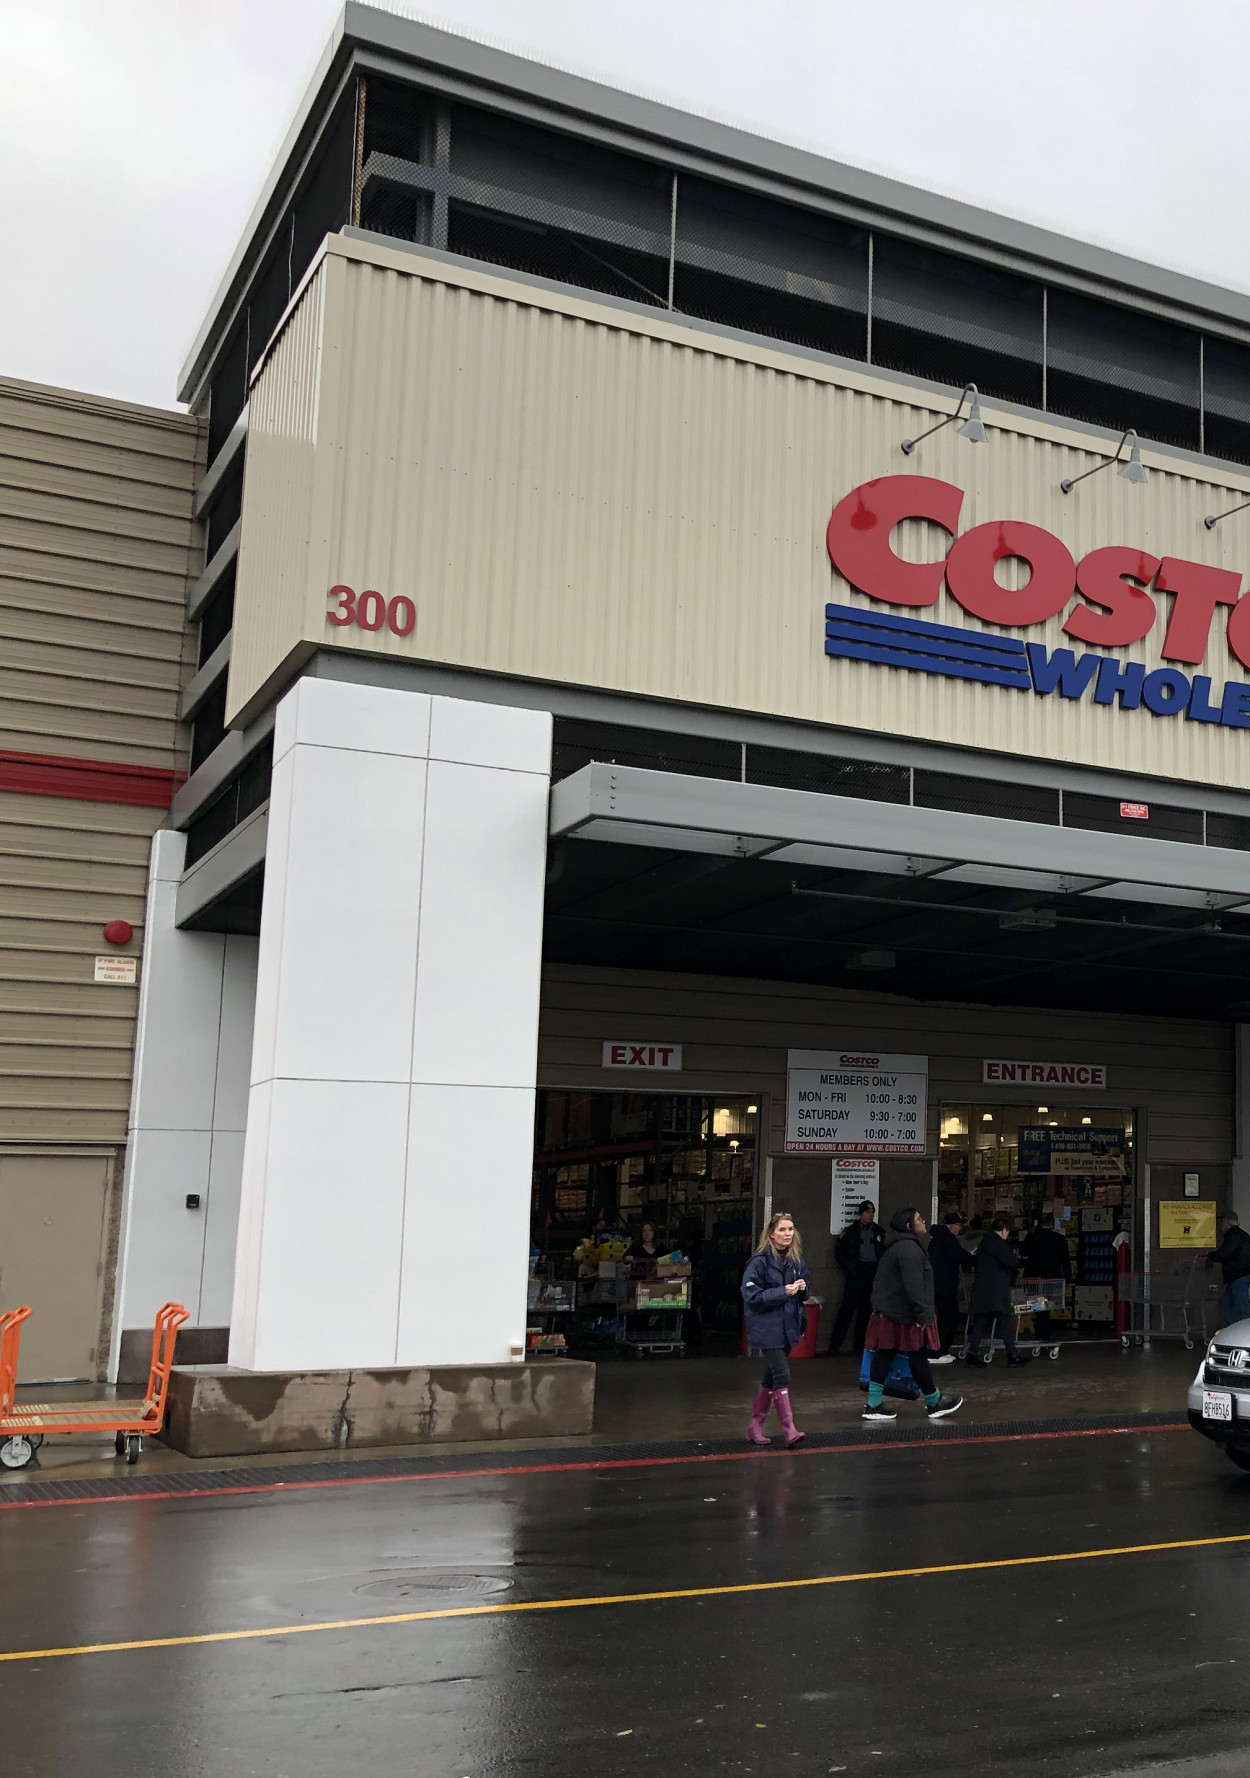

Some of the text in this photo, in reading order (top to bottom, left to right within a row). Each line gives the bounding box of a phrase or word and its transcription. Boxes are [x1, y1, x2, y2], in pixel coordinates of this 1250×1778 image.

[327, 585, 416, 636] 300
[611, 1046, 674, 1066] EXIT
[840, 1055, 879, 1064] COSTCO
[987, 1063, 1102, 1084] ENTRANCE
[821, 1074, 897, 1087] MEMBERS ONLY
[799, 1091, 821, 1102] MON
[831, 1093, 846, 1102] FRI
[866, 1094, 889, 1103] 10:00
[898, 1095, 917, 1105] 8:30
[798, 1109, 850, 1120] SATURDAY
[870, 1112, 889, 1121] 9:30
[898, 1112, 916, 1122] 7:00
[797, 1127, 838, 1138] SUNDAY
[865, 1129, 888, 1139] 10:00
[897, 1130, 915, 1139] 7:00
[1024, 1131, 1118, 1143] FREE Technical Support
[867, 1144, 924, 1152] WWW.COSTCO.COM
